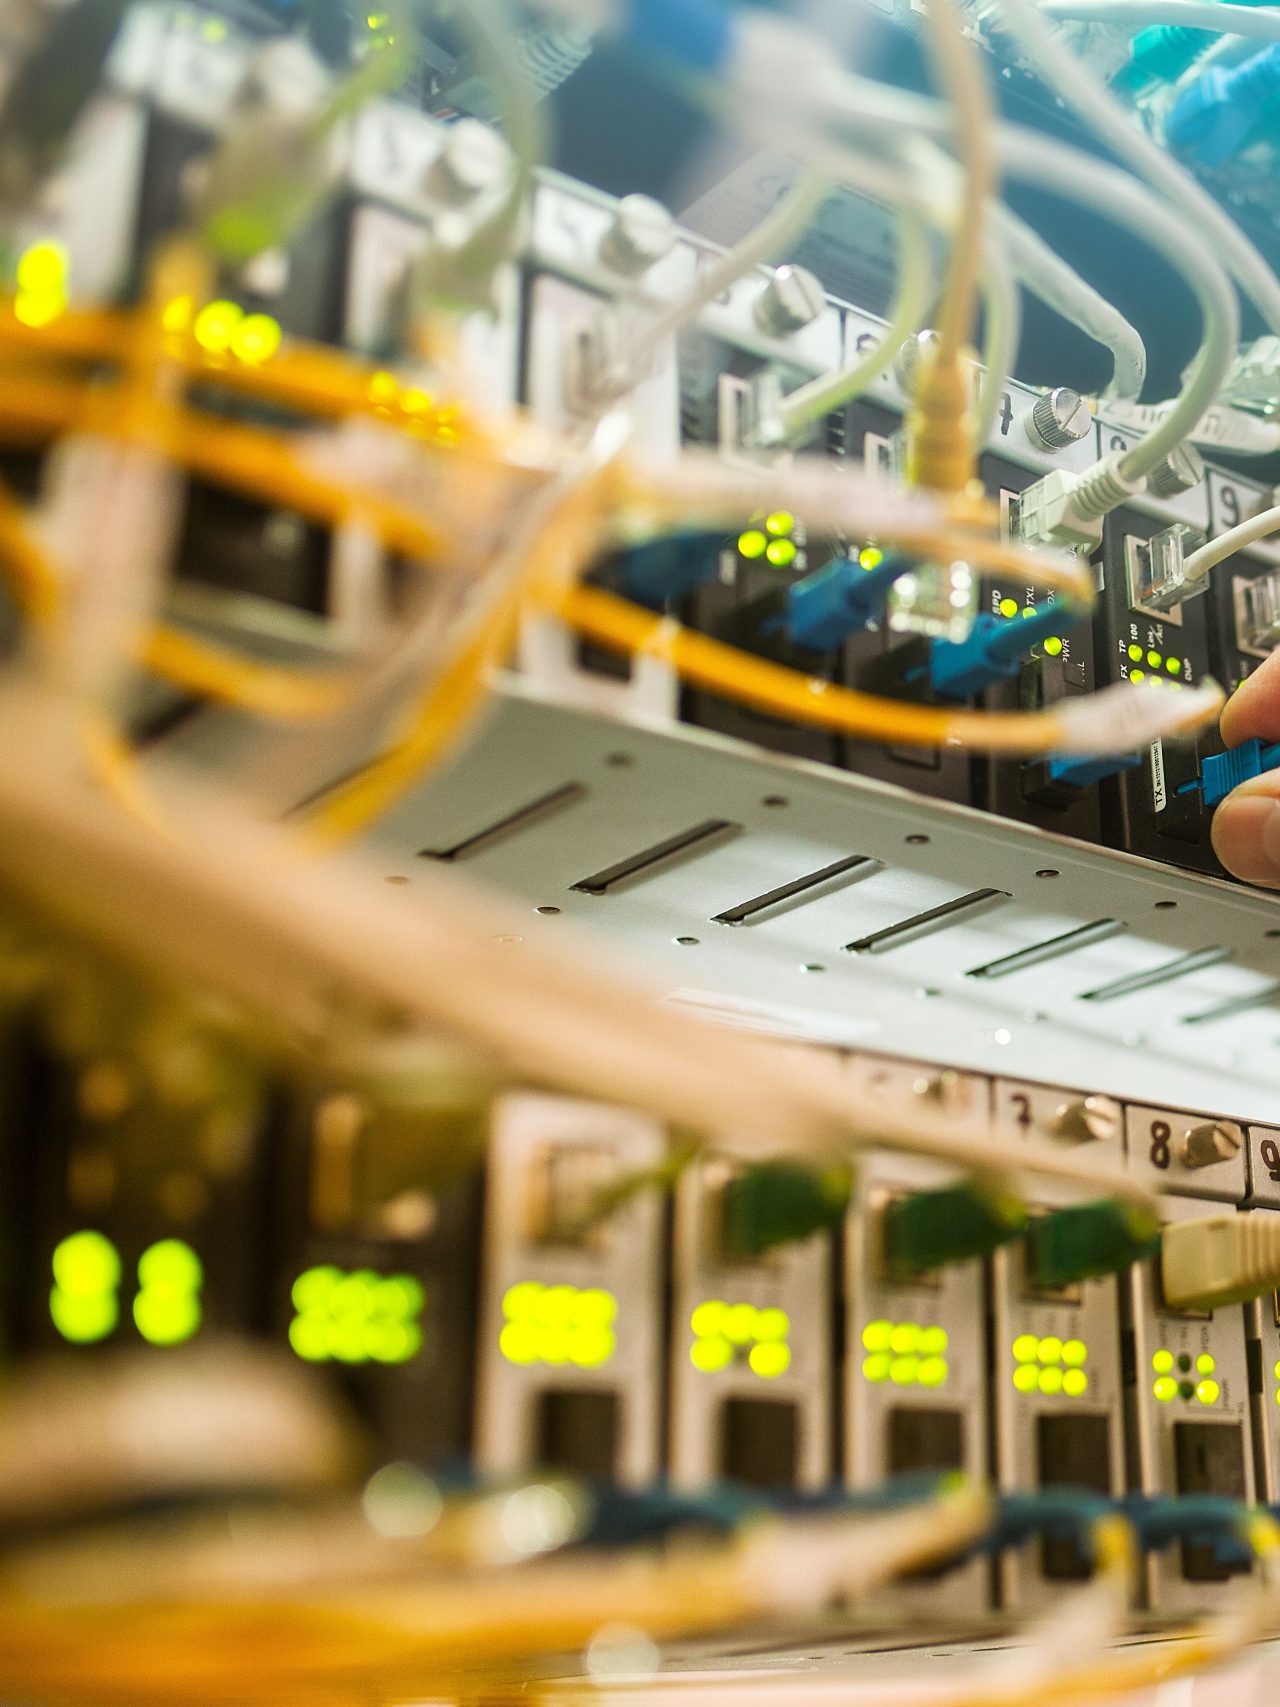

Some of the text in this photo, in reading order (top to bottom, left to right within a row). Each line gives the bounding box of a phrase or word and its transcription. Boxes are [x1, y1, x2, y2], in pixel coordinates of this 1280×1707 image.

[1220, 485, 1241, 528] 9
[1026, 586, 1035, 606] TXL
[1130, 623, 1138, 640] 100
[1118, 639, 1127, 654] TP
[1120, 664, 1129, 680] FX
[1154, 788, 1163, 806] TX
[1150, 1120, 1171, 1169] 8
